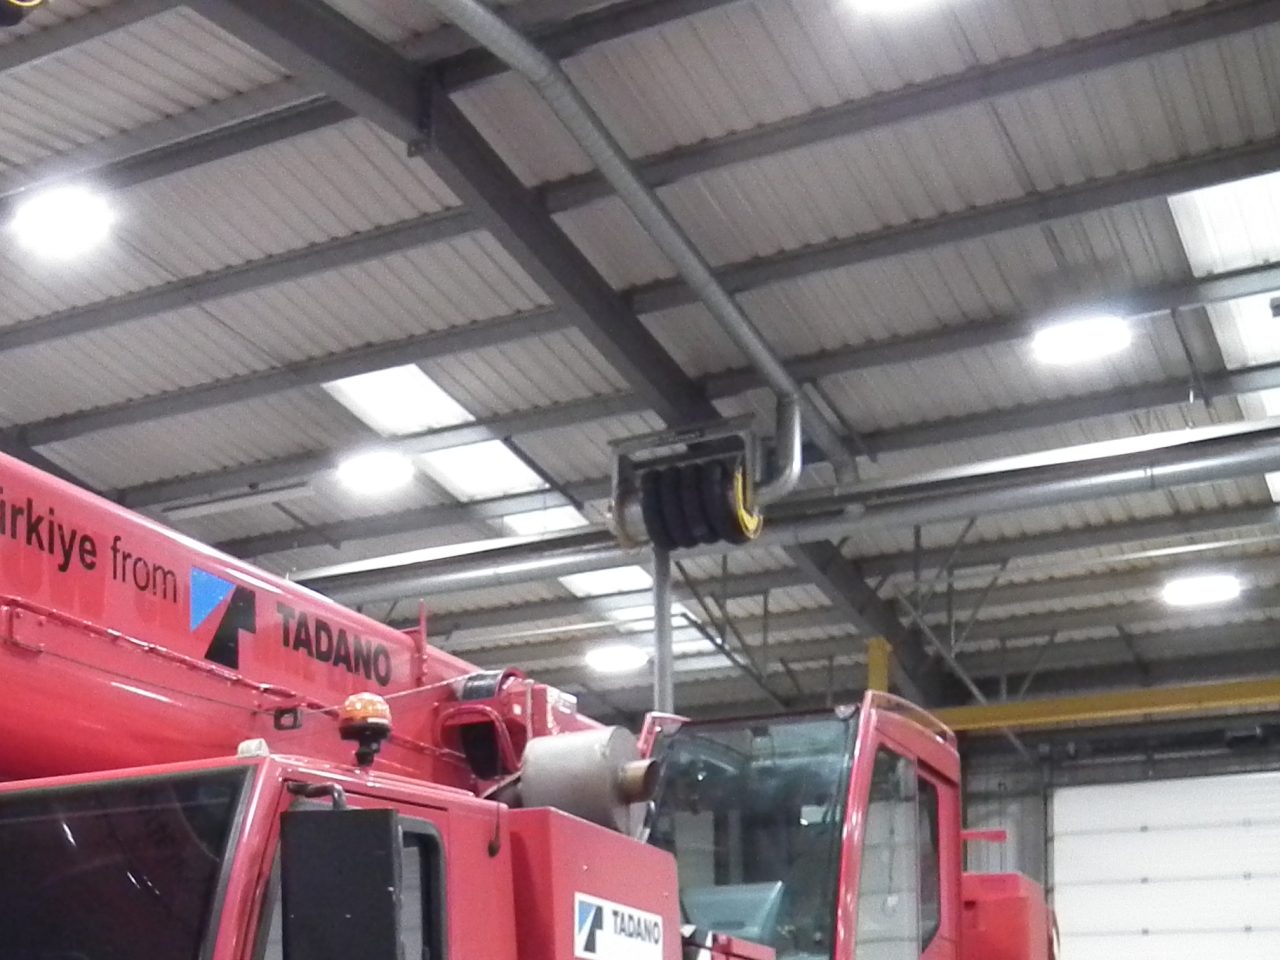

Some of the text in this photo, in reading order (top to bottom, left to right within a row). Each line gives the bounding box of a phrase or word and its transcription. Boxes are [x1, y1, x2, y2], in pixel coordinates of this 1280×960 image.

[110, 535, 178, 604] from
[276, 600, 393, 687] TADANO
[611, 909, 661, 945] TADANO
